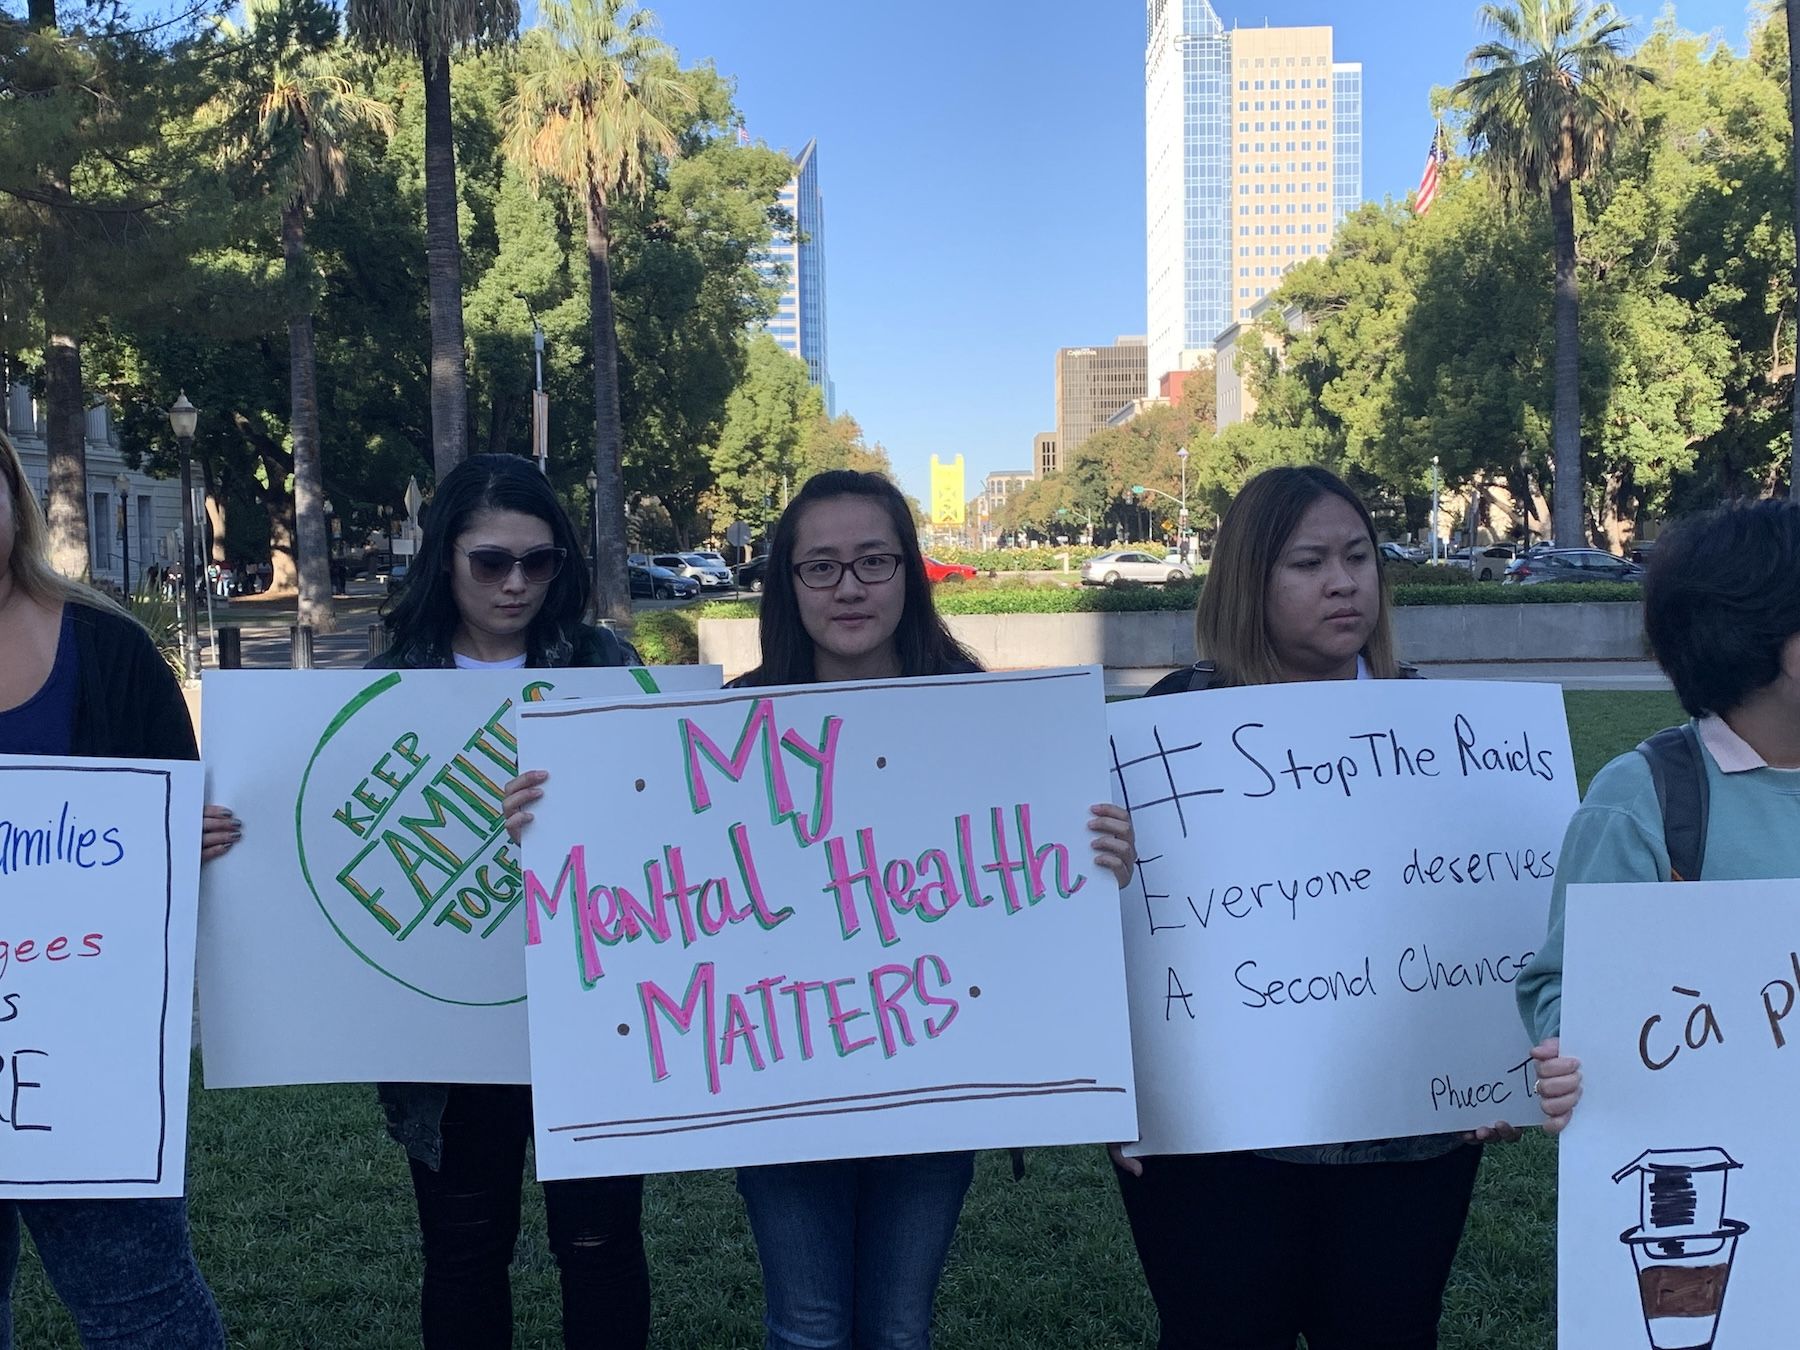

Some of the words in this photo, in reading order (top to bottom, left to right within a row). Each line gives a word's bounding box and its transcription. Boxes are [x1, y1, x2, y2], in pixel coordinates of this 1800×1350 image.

[333, 731, 421, 837] KEEP
[678, 698, 843, 848] My
[433, 838, 523, 935] TOGE
[822, 803, 1088, 948] Health
[1135, 854, 1372, 935] Everyone
[1404, 848, 1555, 885] deserves
[637, 954, 960, 1095] MATTERS
[1165, 967, 1196, 1021] A
[1235, 957, 1375, 1008] Second
[1760, 952, 1800, 1048] p
[1431, 1074, 1512, 1111] Phuoc
